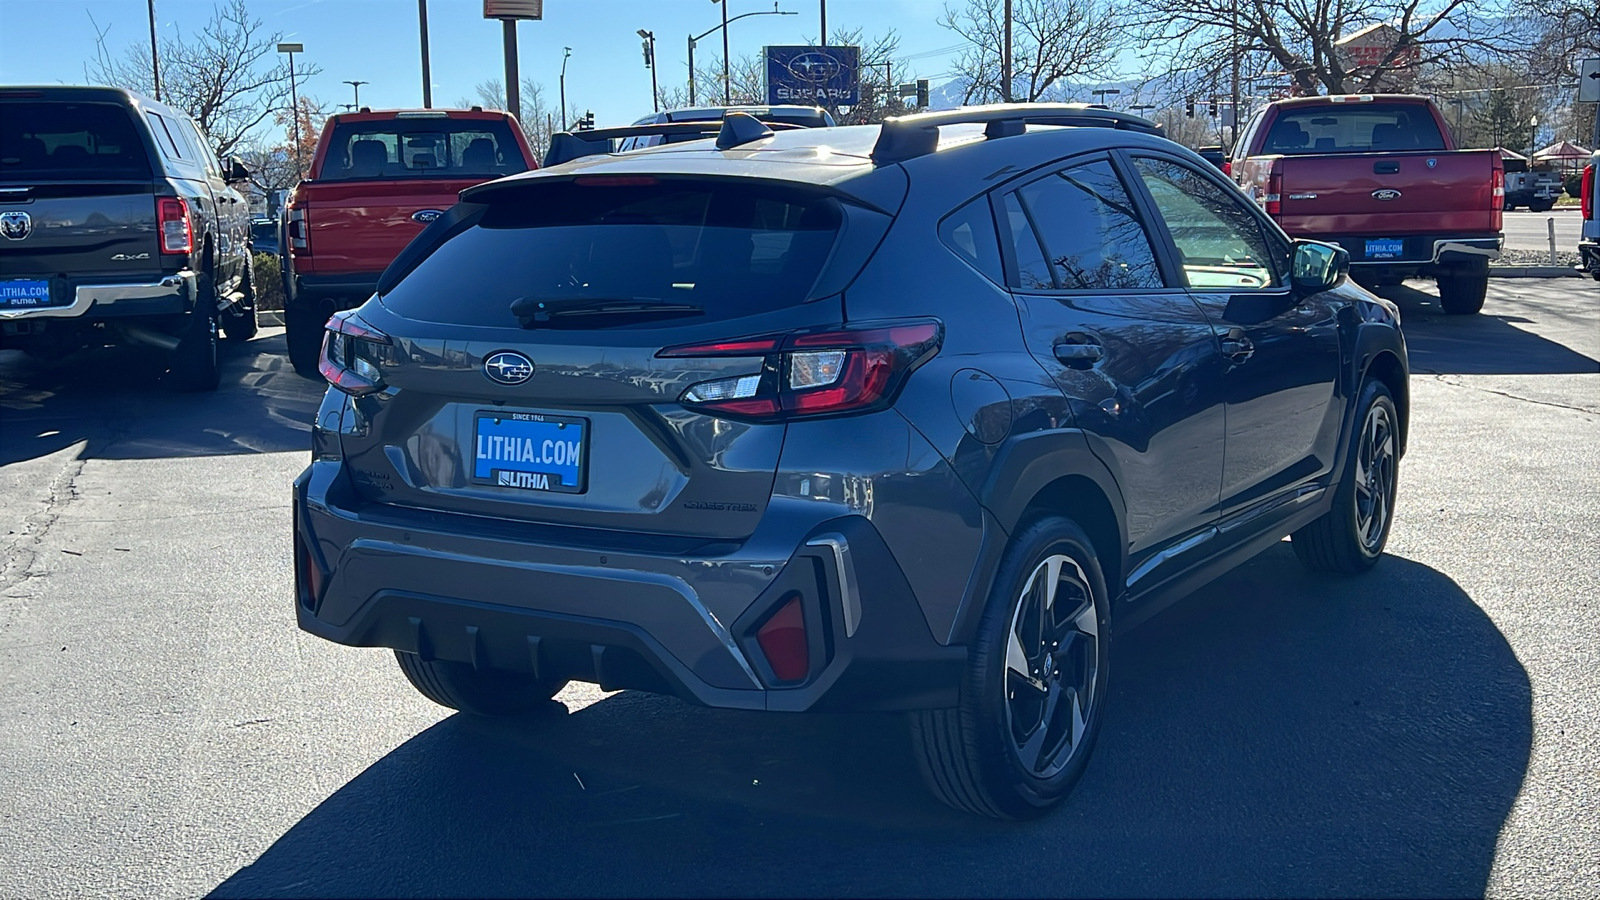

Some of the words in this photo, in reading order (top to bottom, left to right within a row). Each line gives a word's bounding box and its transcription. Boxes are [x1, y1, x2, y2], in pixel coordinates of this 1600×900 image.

[777, 87, 852, 100] SUBARU
[1365, 244, 1403, 252] LITHIA.COM
[512, 413, 530, 421] SINCE
[476, 434, 582, 467] LITHIA.COM
[509, 471, 550, 490] LITHIA
[683, 500, 759, 513] CROSSTREK
